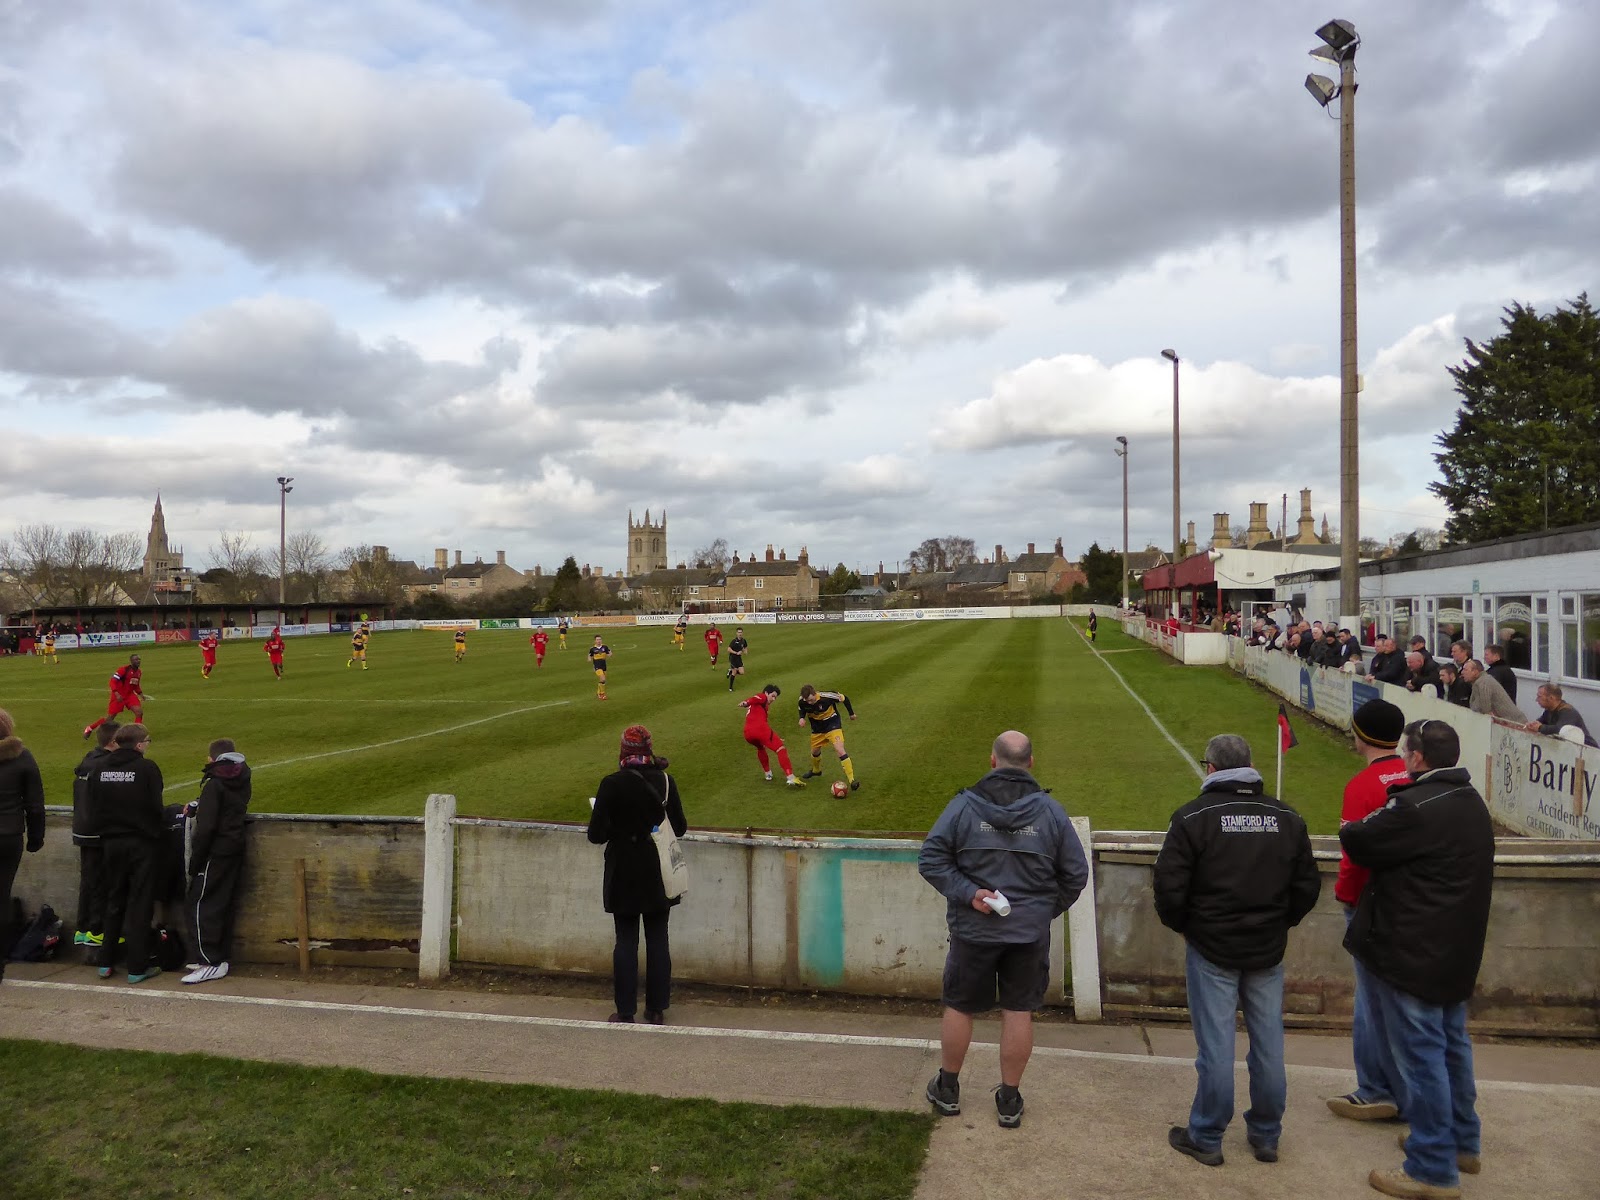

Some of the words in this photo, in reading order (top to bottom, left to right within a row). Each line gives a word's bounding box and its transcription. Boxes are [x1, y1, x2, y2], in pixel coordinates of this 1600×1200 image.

[777, 613, 797, 621] vision
[798, 613, 825, 622] express
[1220, 815, 1262, 827] STAMFORD
[1263, 815, 1278, 827] AFC
[1222, 825, 1242, 833] FOOTBALL
